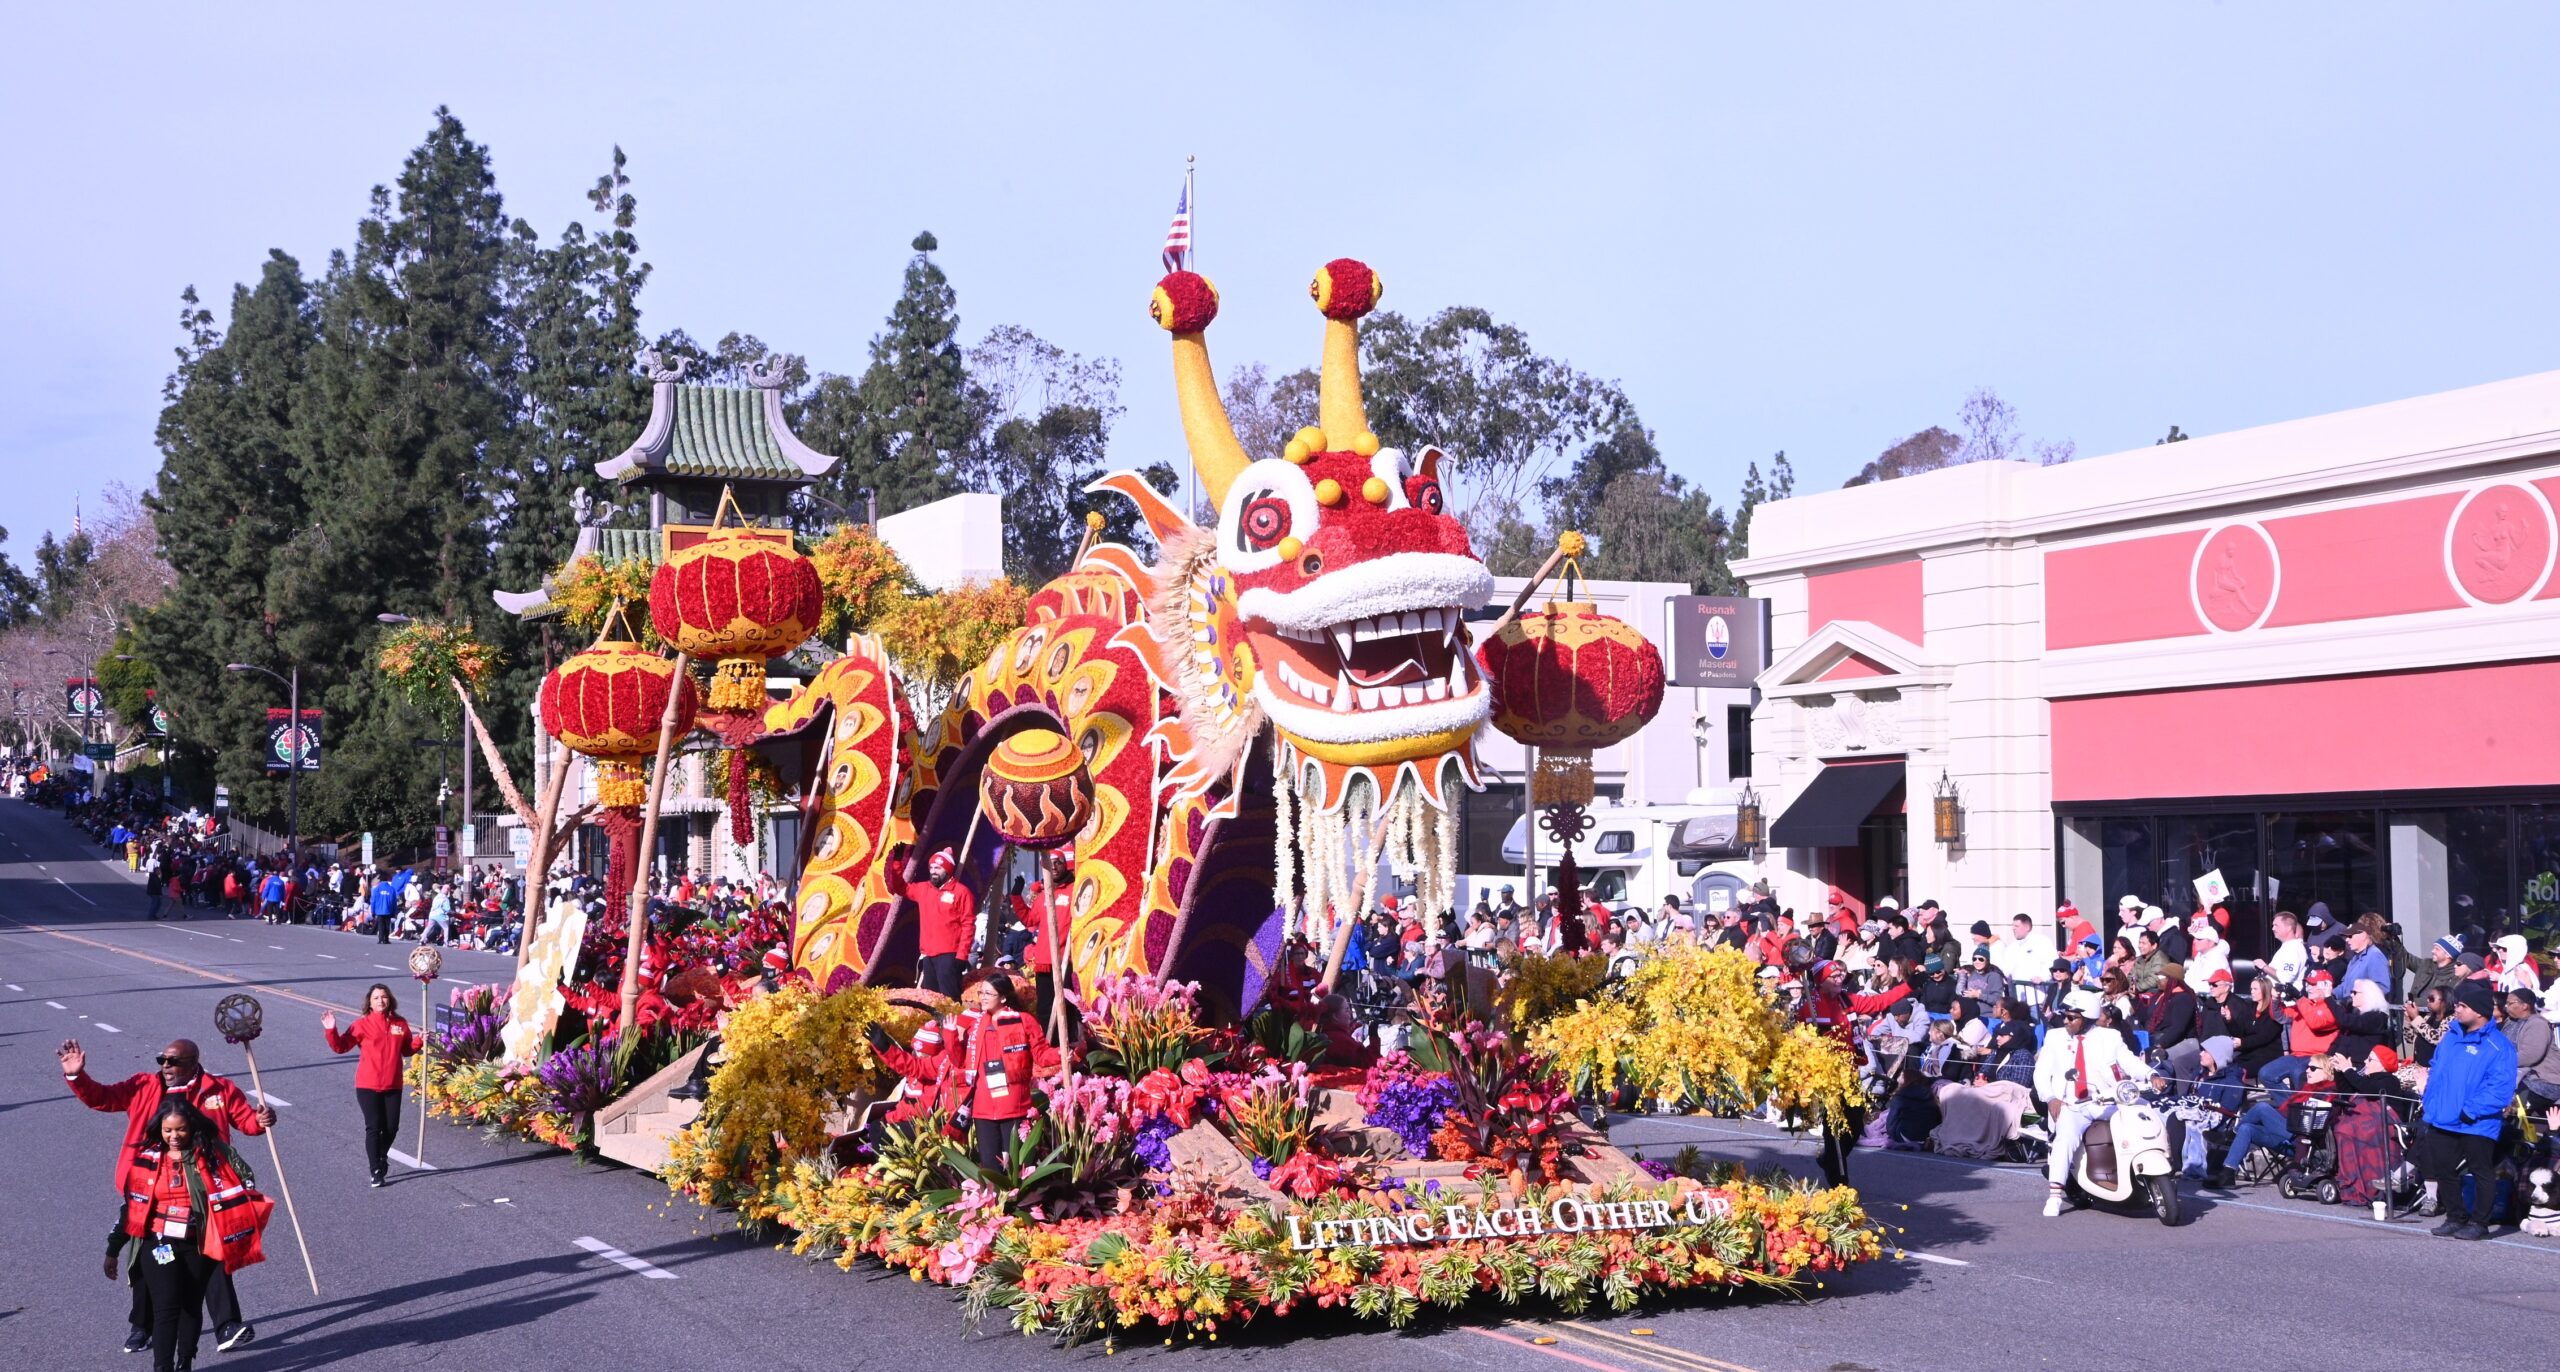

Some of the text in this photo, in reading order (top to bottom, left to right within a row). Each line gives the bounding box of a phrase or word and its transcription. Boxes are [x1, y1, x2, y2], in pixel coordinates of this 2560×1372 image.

[1698, 604, 1736, 615] Rusnak
[1699, 659, 1737, 669] Maserati
[270, 722, 320, 748] ROSE PARADE
[2163, 887, 2257, 902] MASATI
[2283, 963, 2294, 971] 26
[1286, 1191, 1730, 1250] LIFTING EACH OTHER UP
